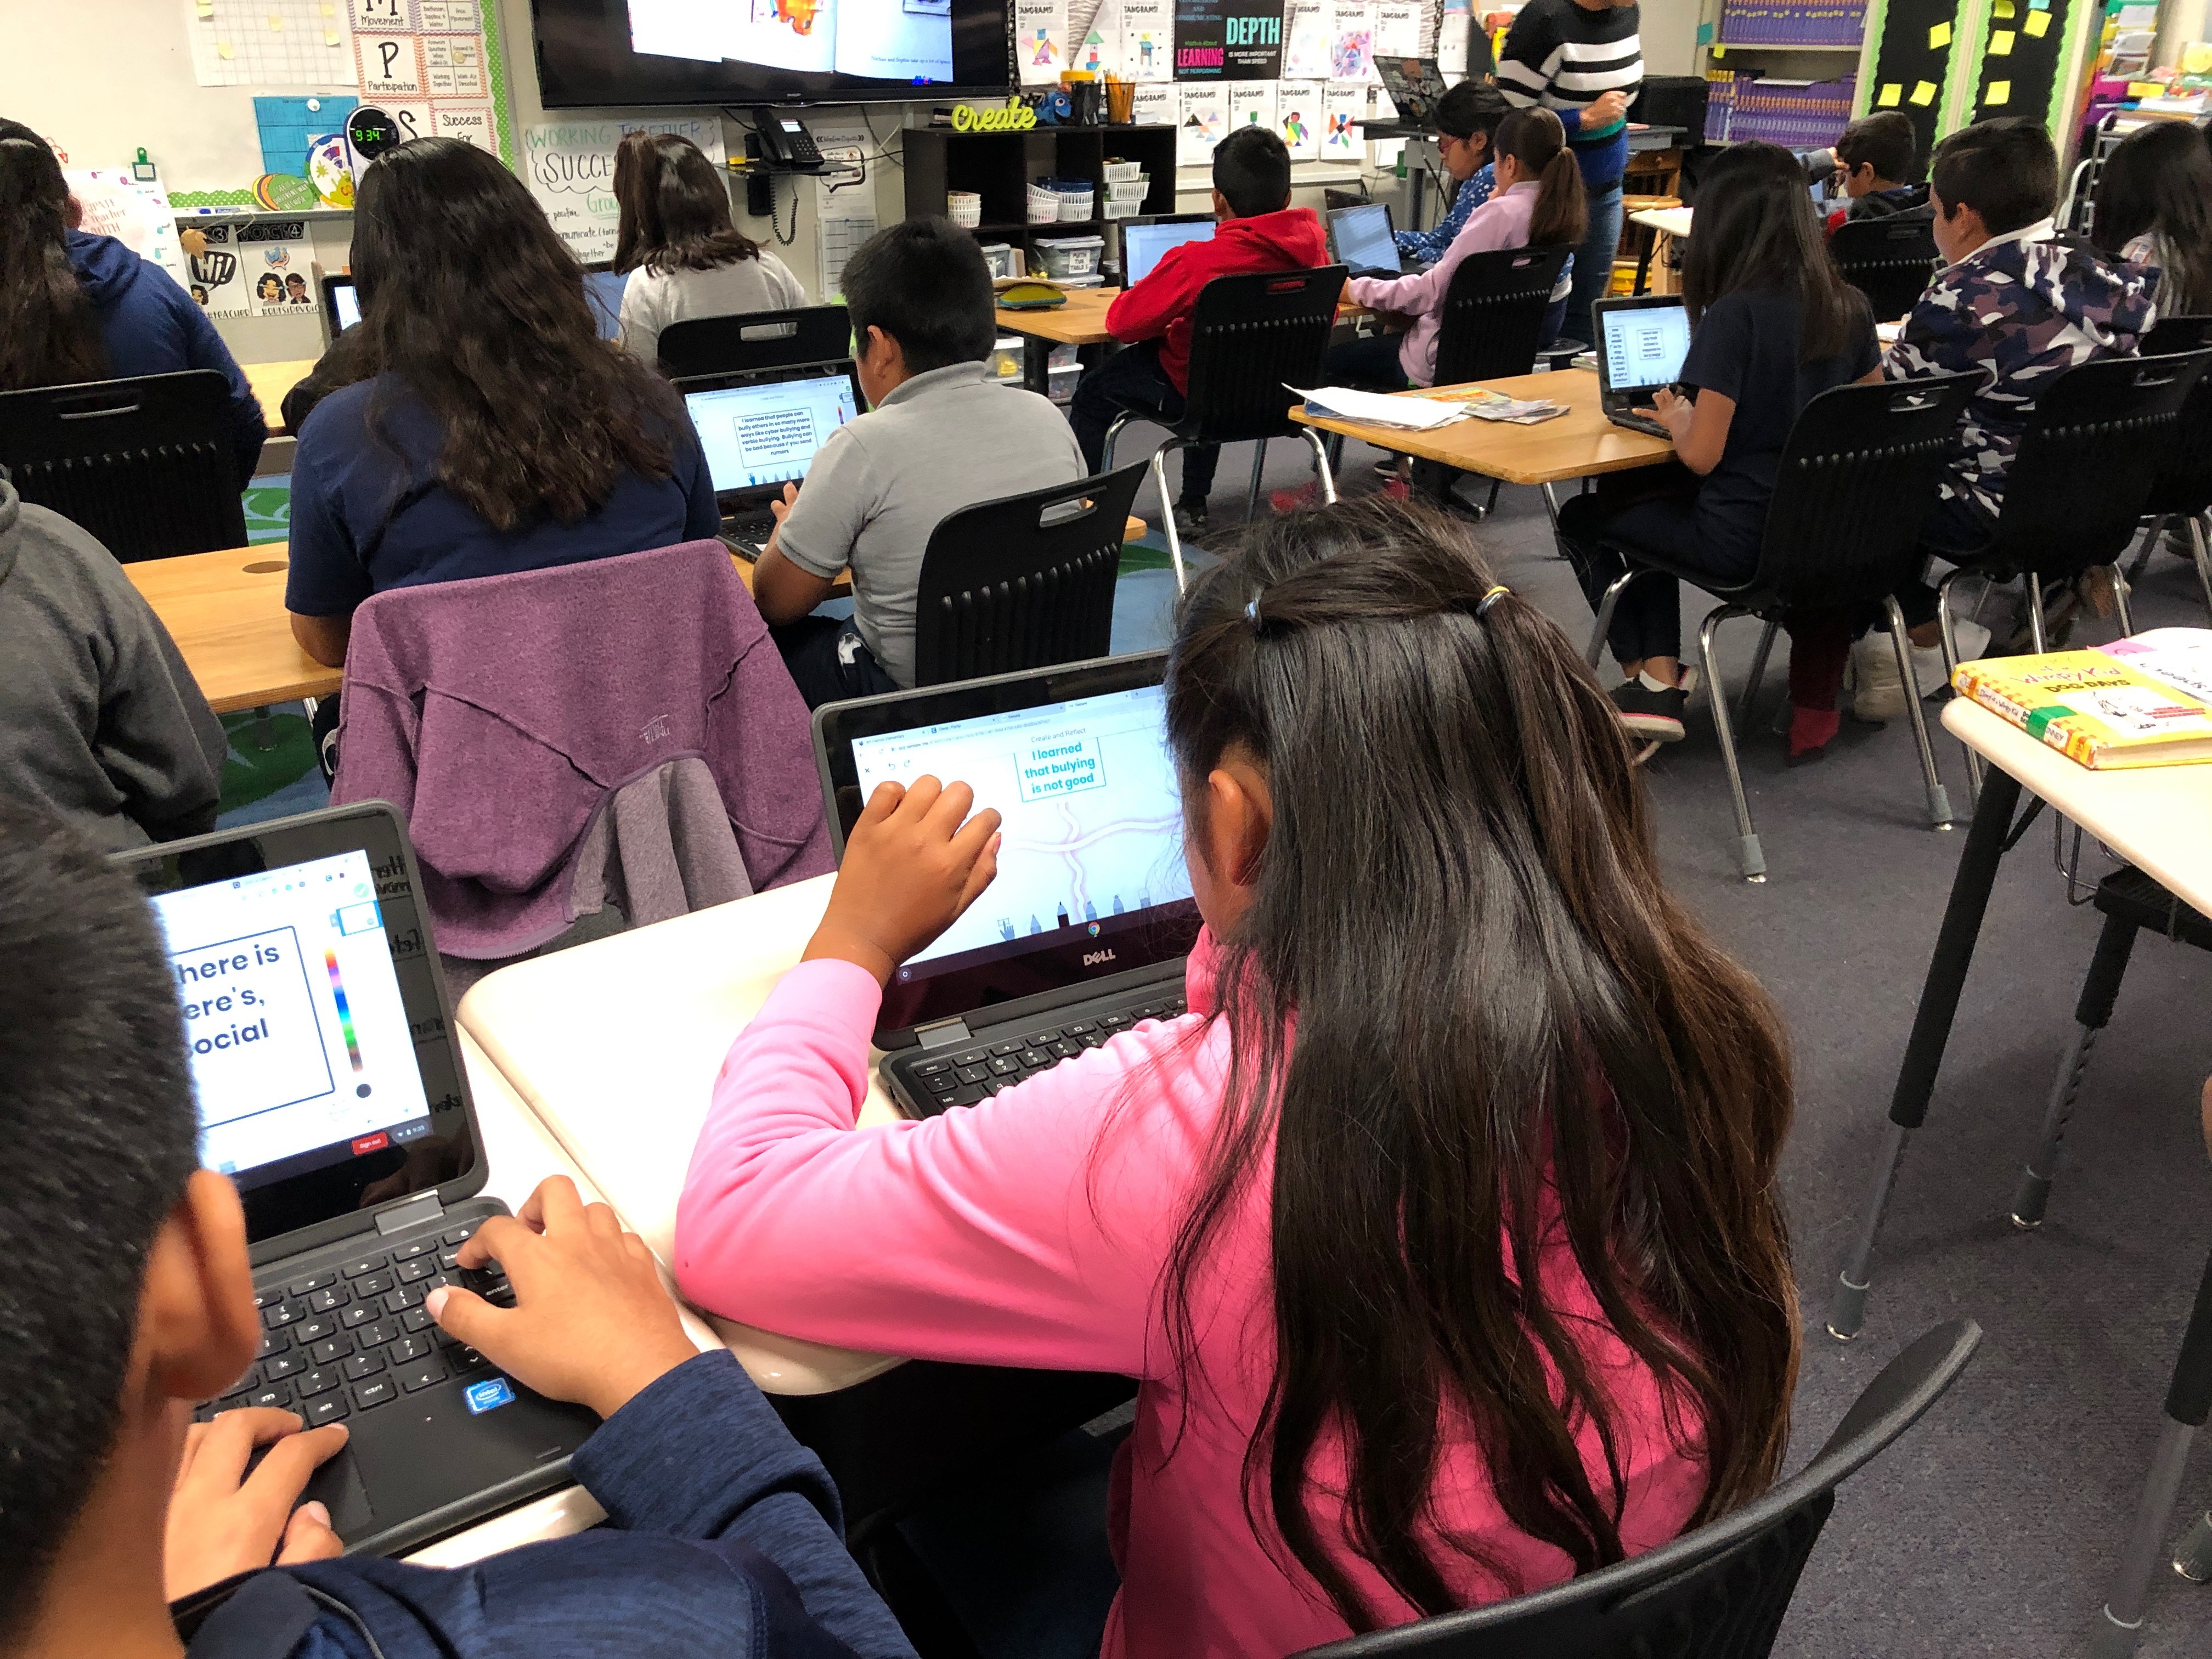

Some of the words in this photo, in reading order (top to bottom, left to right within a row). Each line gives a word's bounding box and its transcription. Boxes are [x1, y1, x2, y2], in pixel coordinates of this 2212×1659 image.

[361, 15, 404, 26] Movement
[1226, 17, 1280, 45] DEPTH
[379, 42, 399, 78] P
[1177, 47, 1224, 67] LEARNING
[368, 81, 417, 93] Participation
[443, 114, 482, 126] Success
[951, 95, 1037, 131] Create
[531, 126, 611, 148] WORKING
[543, 153, 613, 183] SUCCE
[586, 194, 620, 215] Grou
[198, 255, 233, 282] Hi!
[2043, 682, 2084, 692] DOG
[1031, 733, 1051, 743] Create
[1053, 731, 1064, 740] and
[1065, 727, 1086, 736] Reflect
[1032, 751, 1036, 760] I
[1037, 742, 1082, 759] learned
[1024, 764, 1049, 778] that
[1051, 757, 1096, 773] bulying
[1031, 783, 1041, 794] is
[1044, 778, 1063, 791] not
[1065, 772, 1094, 790] good
[178, 955, 249, 984] here
[254, 944, 280, 966] is
[1083, 949, 1116, 966] DELL
[184, 986, 265, 1020] ere's,
[194, 1018, 269, 1054] ocial
[486, 1283, 510, 1296] enter
[261, 1393, 275, 1402] m
[365, 1384, 383, 1395] ctrl
[478, 1386, 498, 1398] intel
[318, 1402, 333, 1412] alt
